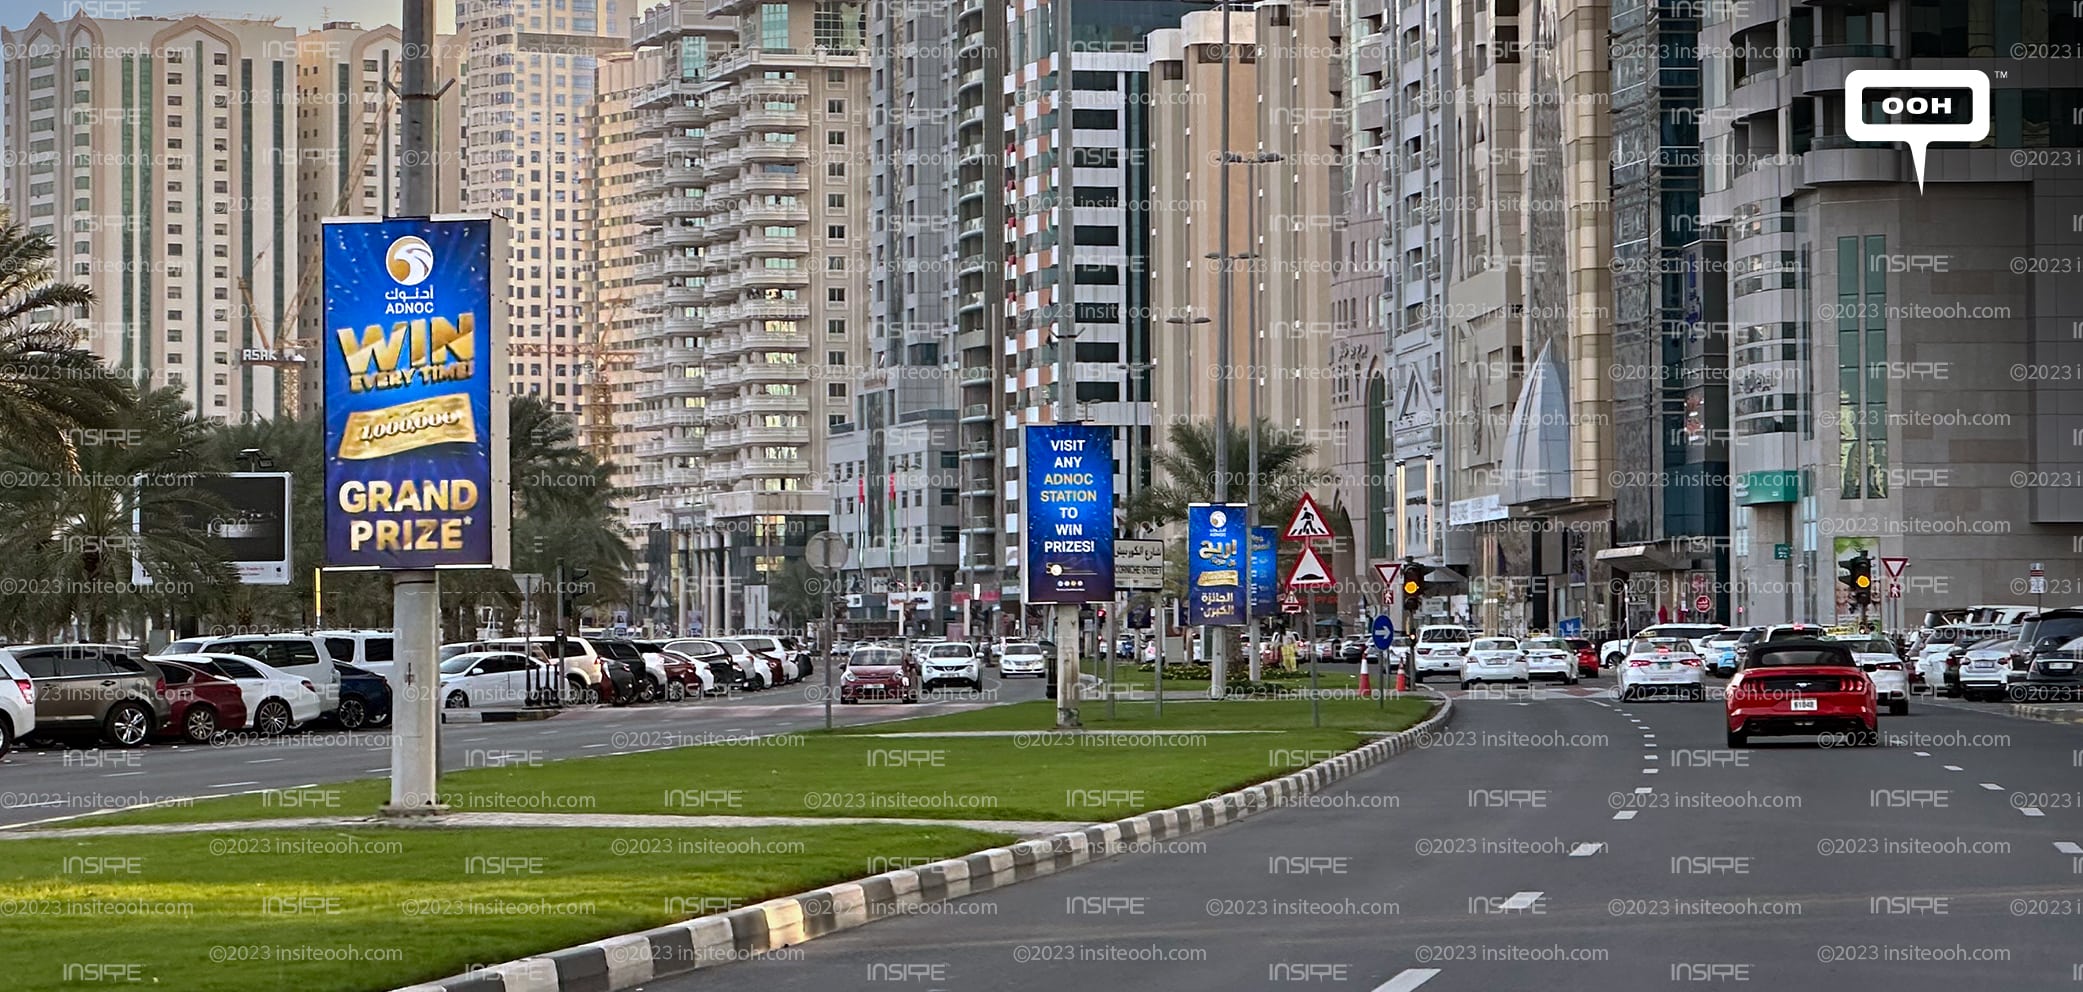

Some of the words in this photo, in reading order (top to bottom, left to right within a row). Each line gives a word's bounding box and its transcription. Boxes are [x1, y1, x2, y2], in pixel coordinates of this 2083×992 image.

[385, 302, 434, 314] ADNOC
[336, 312, 475, 375] WIN
[350, 370, 415, 392] EVERY
[1050, 439, 1086, 452] VISIT
[1054, 456, 1083, 469] ANY
[1043, 473, 1094, 486] ADNOC
[338, 479, 479, 513] GRAND
[1040, 489, 1097, 502] STATION
[1059, 506, 1079, 519] TO
[1055, 524, 1083, 536] WIN
[1044, 540, 1095, 553] PRIZES!
